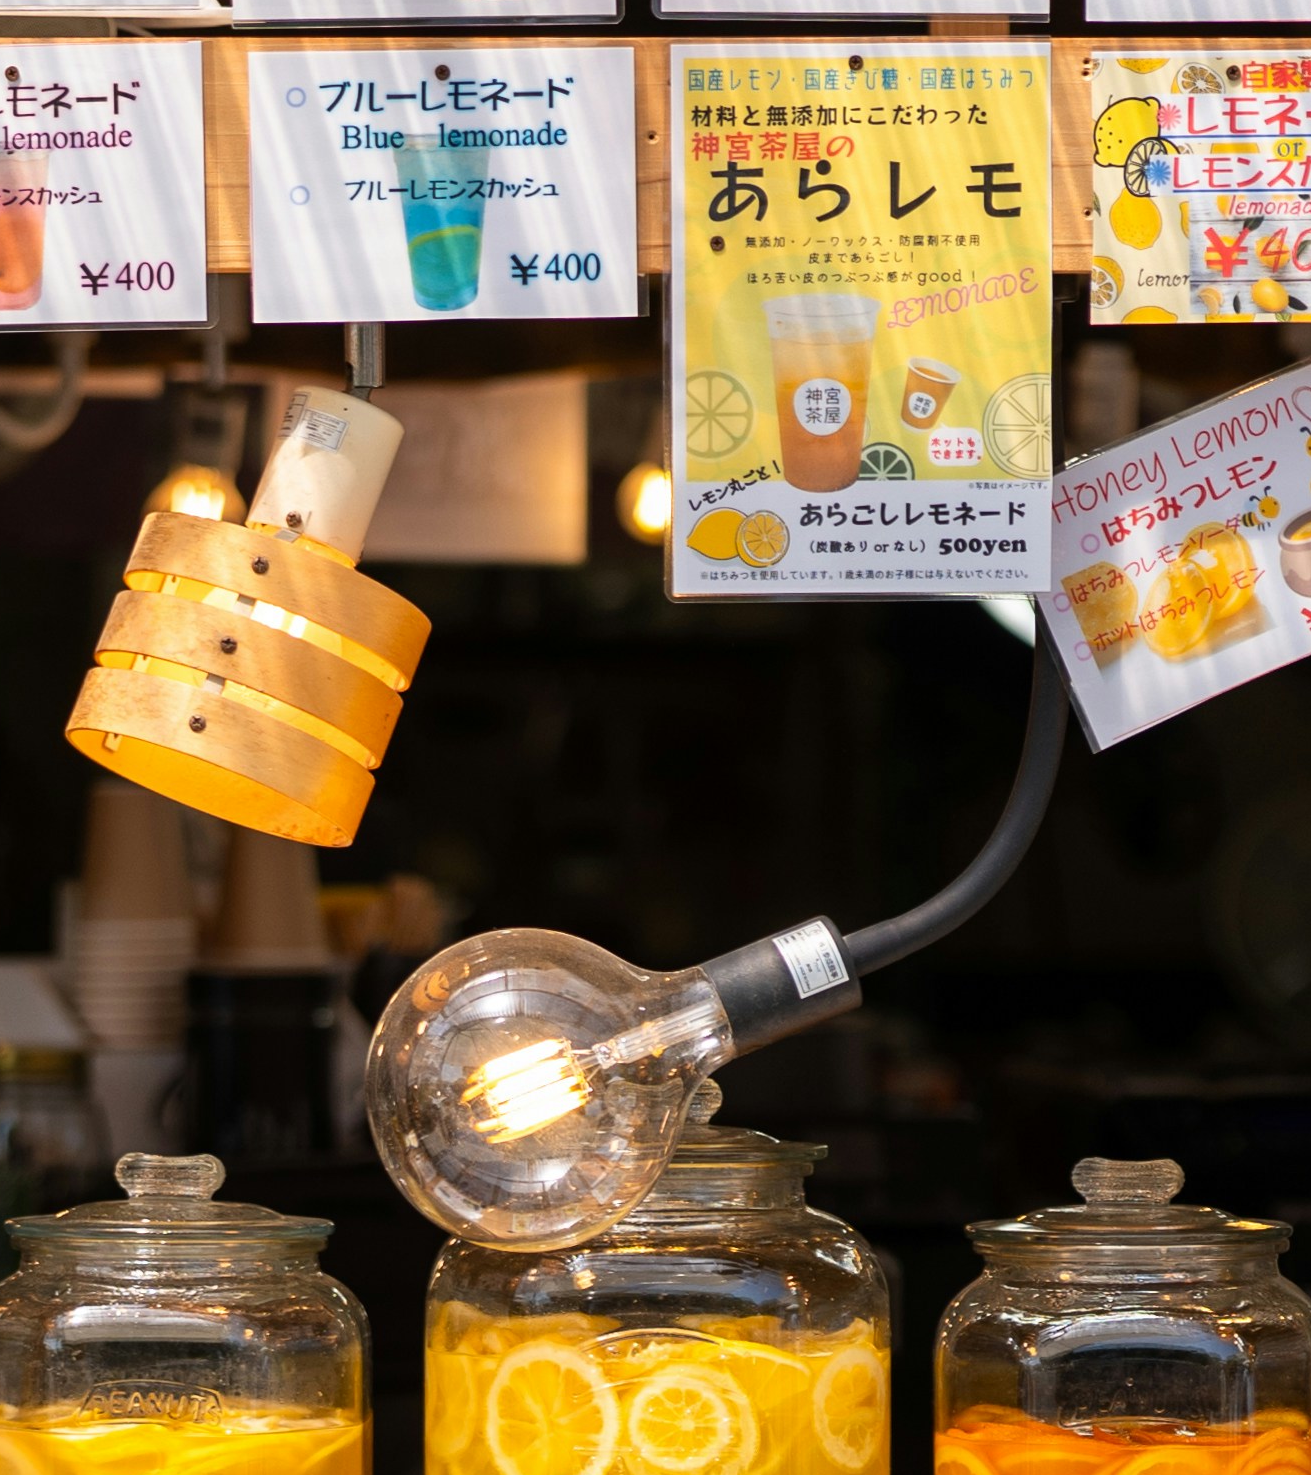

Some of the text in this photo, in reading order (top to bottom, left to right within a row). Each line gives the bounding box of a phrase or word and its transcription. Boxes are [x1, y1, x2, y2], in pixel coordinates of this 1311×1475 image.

[319, 77, 573, 112] ブルーレモネード
[692, 104, 988, 126] 材料と無添加にこだわった
[3, 123, 132, 150] lemonade
[342, 121, 567, 149] Blue lemonade
[692, 132, 855, 162] 神宮茶屋の
[1278, 140, 1302, 157] or
[345, 178, 559, 201] ブルーレモンスカッシュ
[708, 159, 1022, 222] あらレモ
[80, 261, 174, 295] ¥400
[511, 253, 600, 285] ¥400
[1051, 397, 1293, 524] Honey Lemon
[800, 503, 1026, 526] あらごしレモネード
[1101, 455, 1277, 547] はちみつレモン
[939, 537, 1026, 556] 500yen
[1070, 515, 1245, 604] はちみつレモンソーダ
[1093, 567, 1266, 652] ホットはちみつレモン
